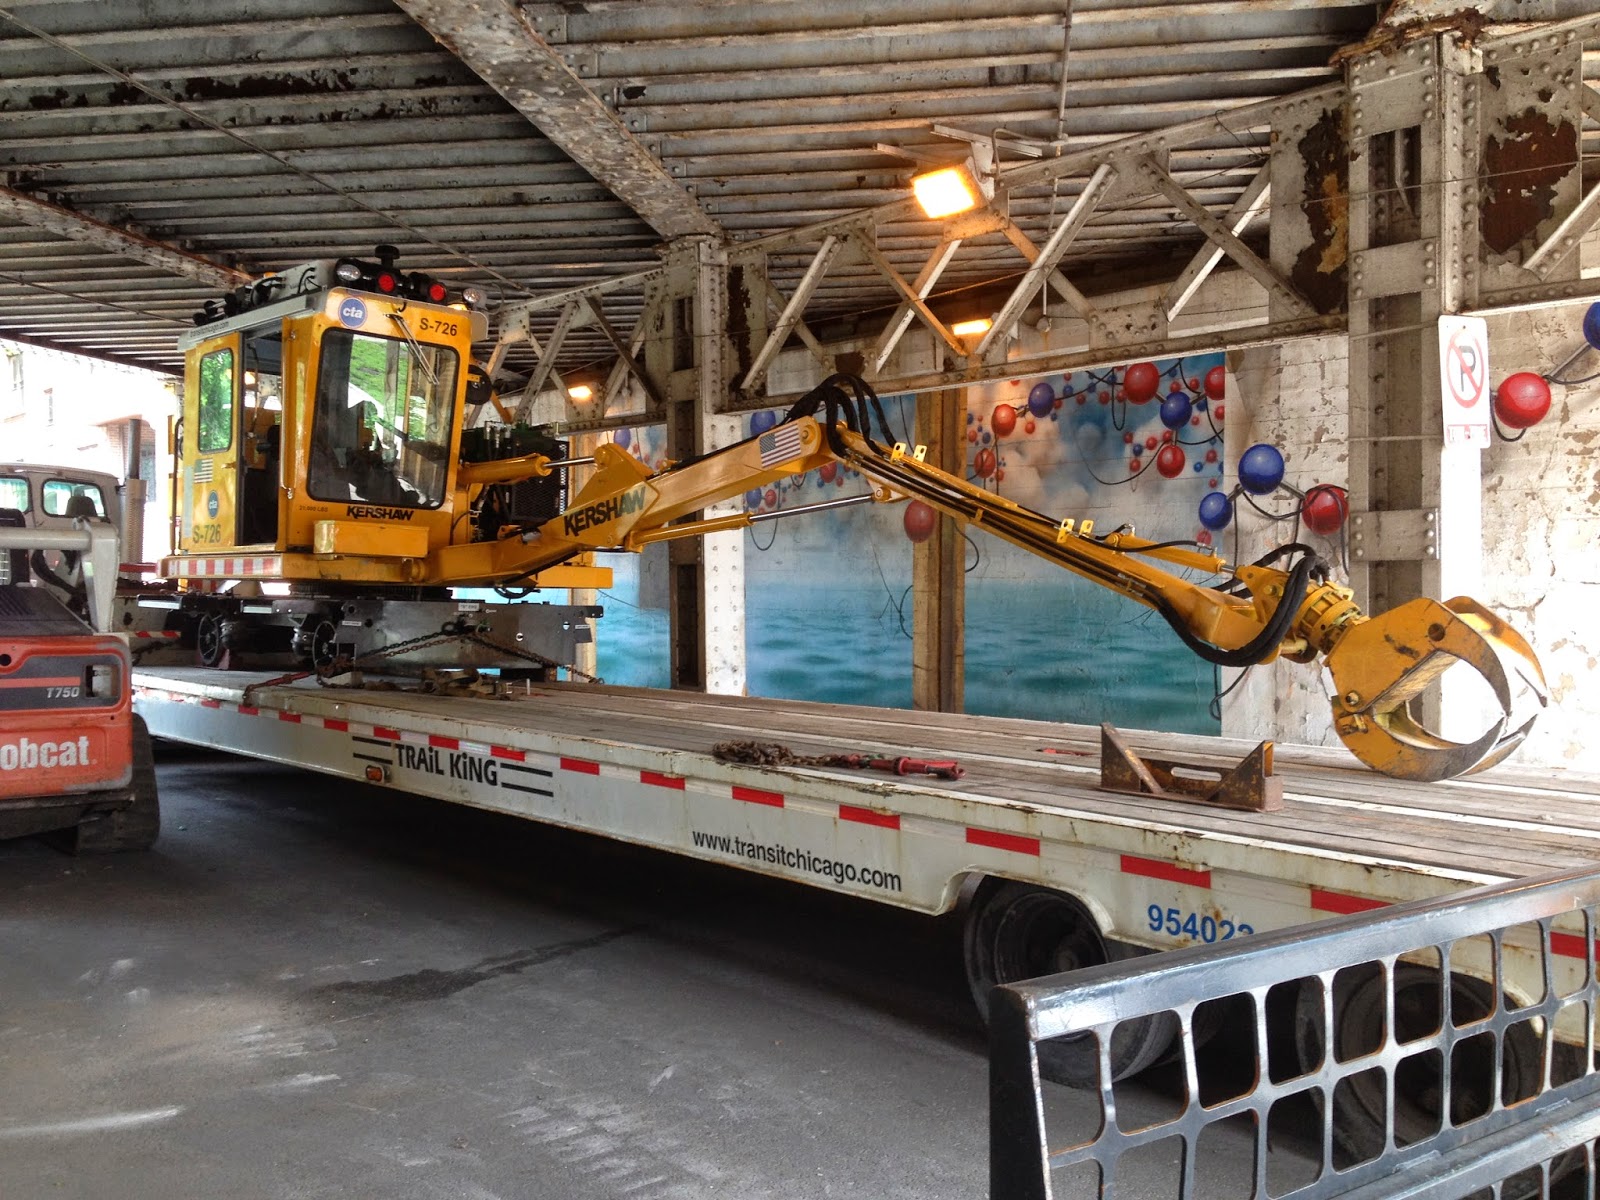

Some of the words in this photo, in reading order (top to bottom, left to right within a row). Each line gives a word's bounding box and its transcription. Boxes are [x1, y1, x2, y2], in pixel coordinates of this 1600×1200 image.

[342, 306, 363, 319] cta
[419, 317, 458, 337] S-726
[346, 505, 414, 520] KERSHAW
[564, 485, 646, 537] KERSHAW
[193, 524, 222, 544] S-726
[46, 686, 80, 698] T750
[692, 831, 903, 892] www.transitchicago.com
